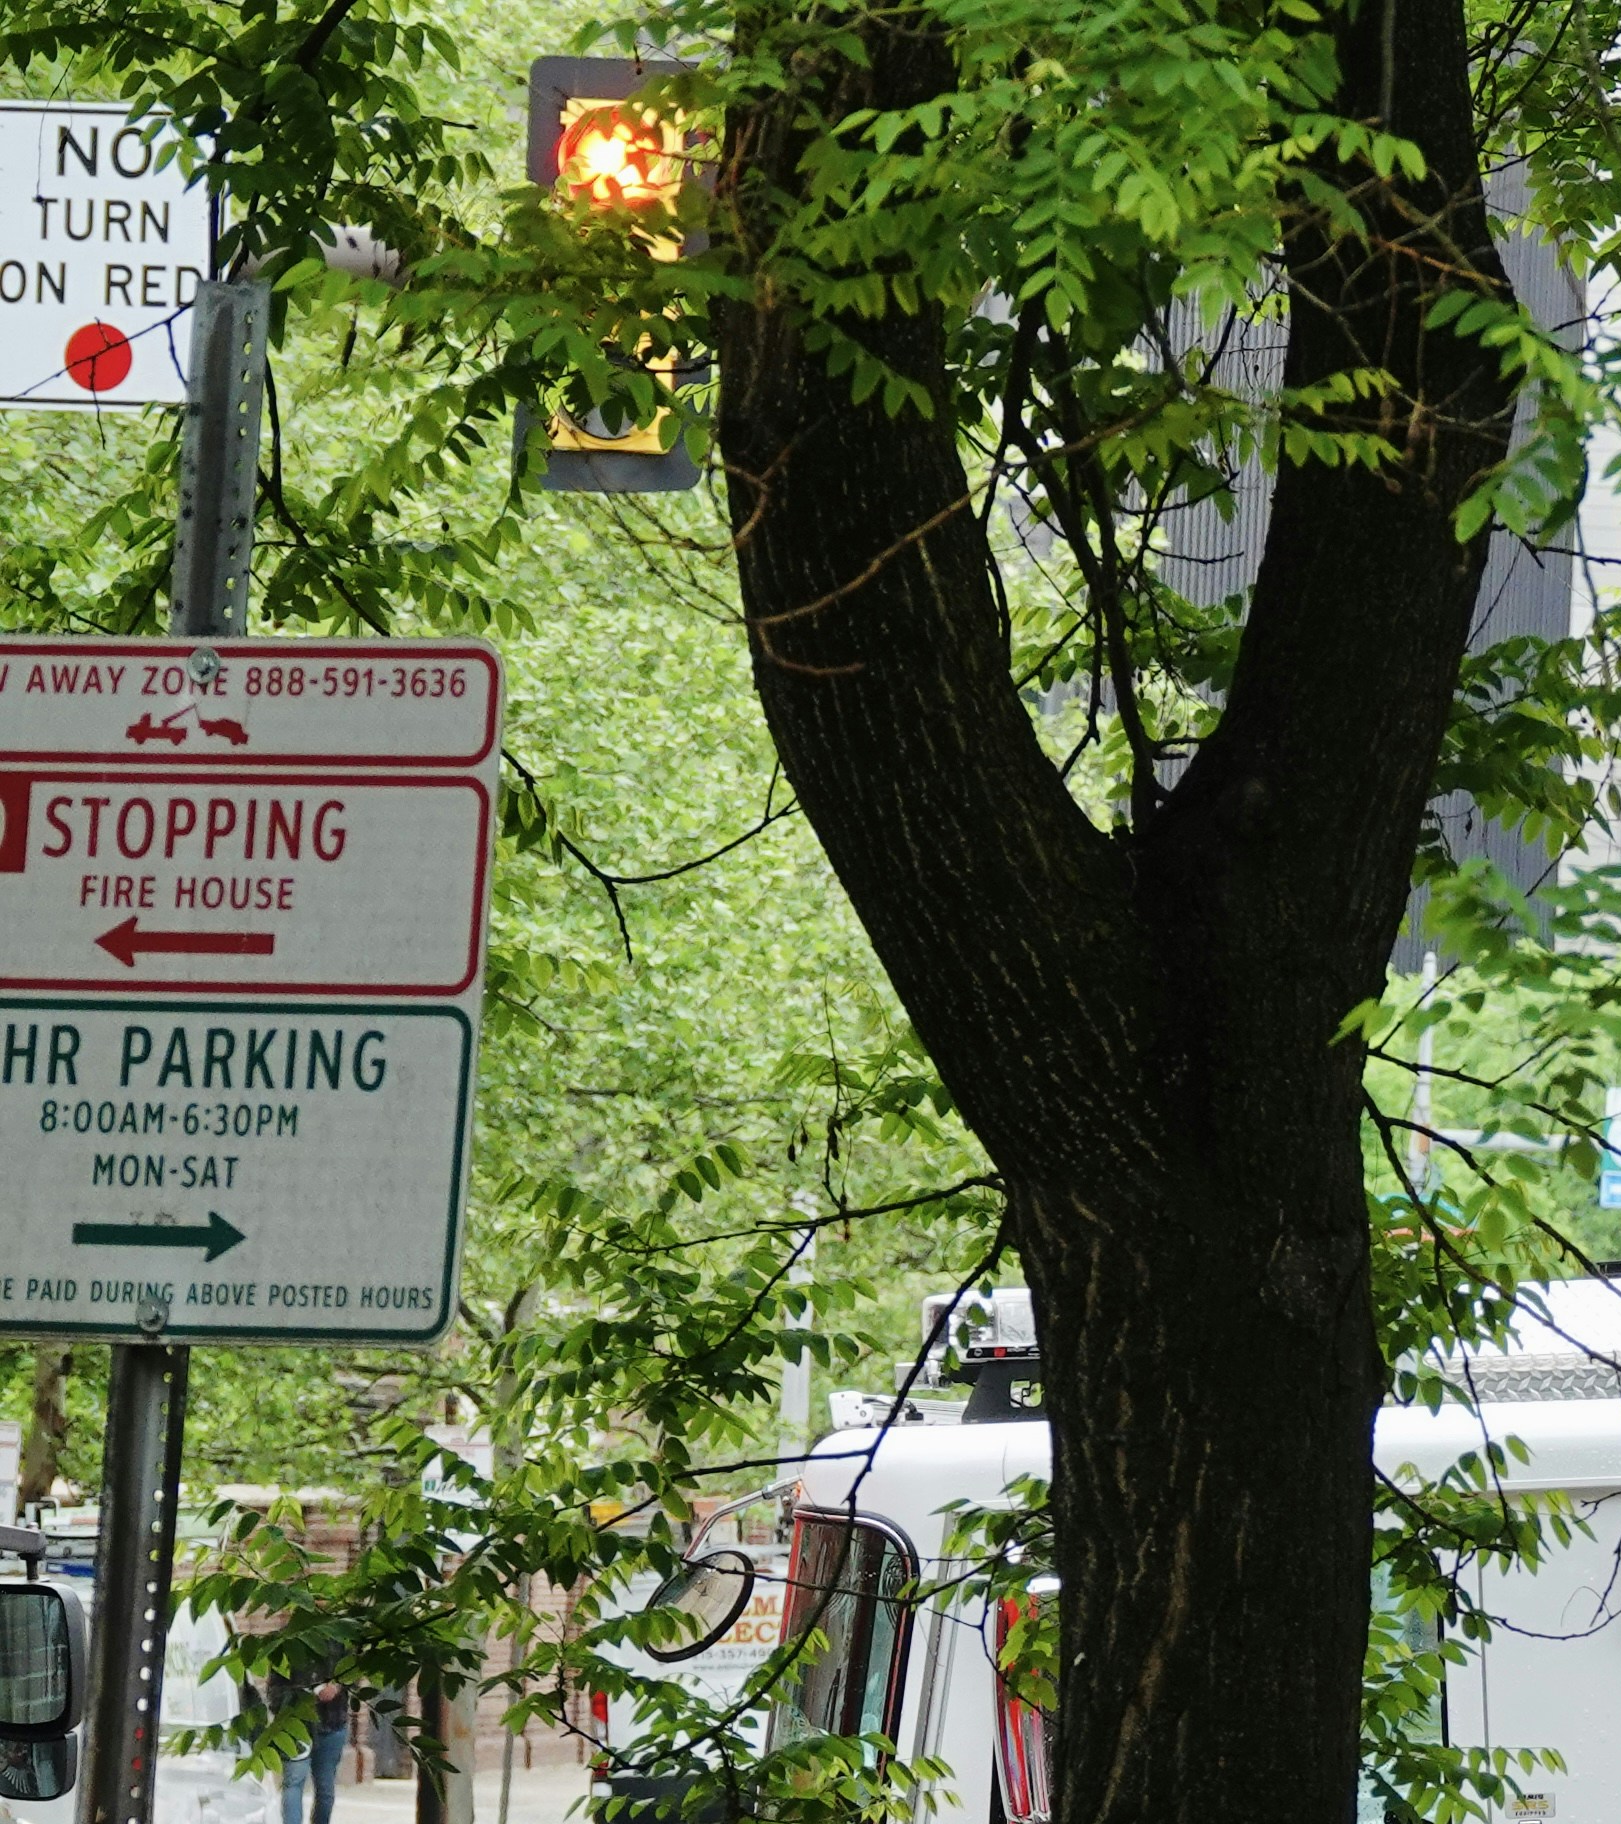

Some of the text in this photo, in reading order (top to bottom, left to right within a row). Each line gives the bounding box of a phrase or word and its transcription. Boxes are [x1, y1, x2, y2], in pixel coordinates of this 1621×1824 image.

[56, 126, 153, 179] NO
[33, 197, 170, 244] TURN
[0, 259, 204, 308] ON RED
[25, 663, 126, 696] AWAY
[245, 667, 467, 698] 888-591-3636
[42, 796, 348, 862] STOPPING
[80, 875, 294, 911] FIRE HOUSE
[2, 1023, 389, 1092] HR PARKING
[39, 1100, 300, 1137] 8:00AM-6:30PM
[92, 1154, 240, 1189] MON-SAT
[0, 1278, 434, 1311] E PAID DURING ABOVE POSTED HOURS
